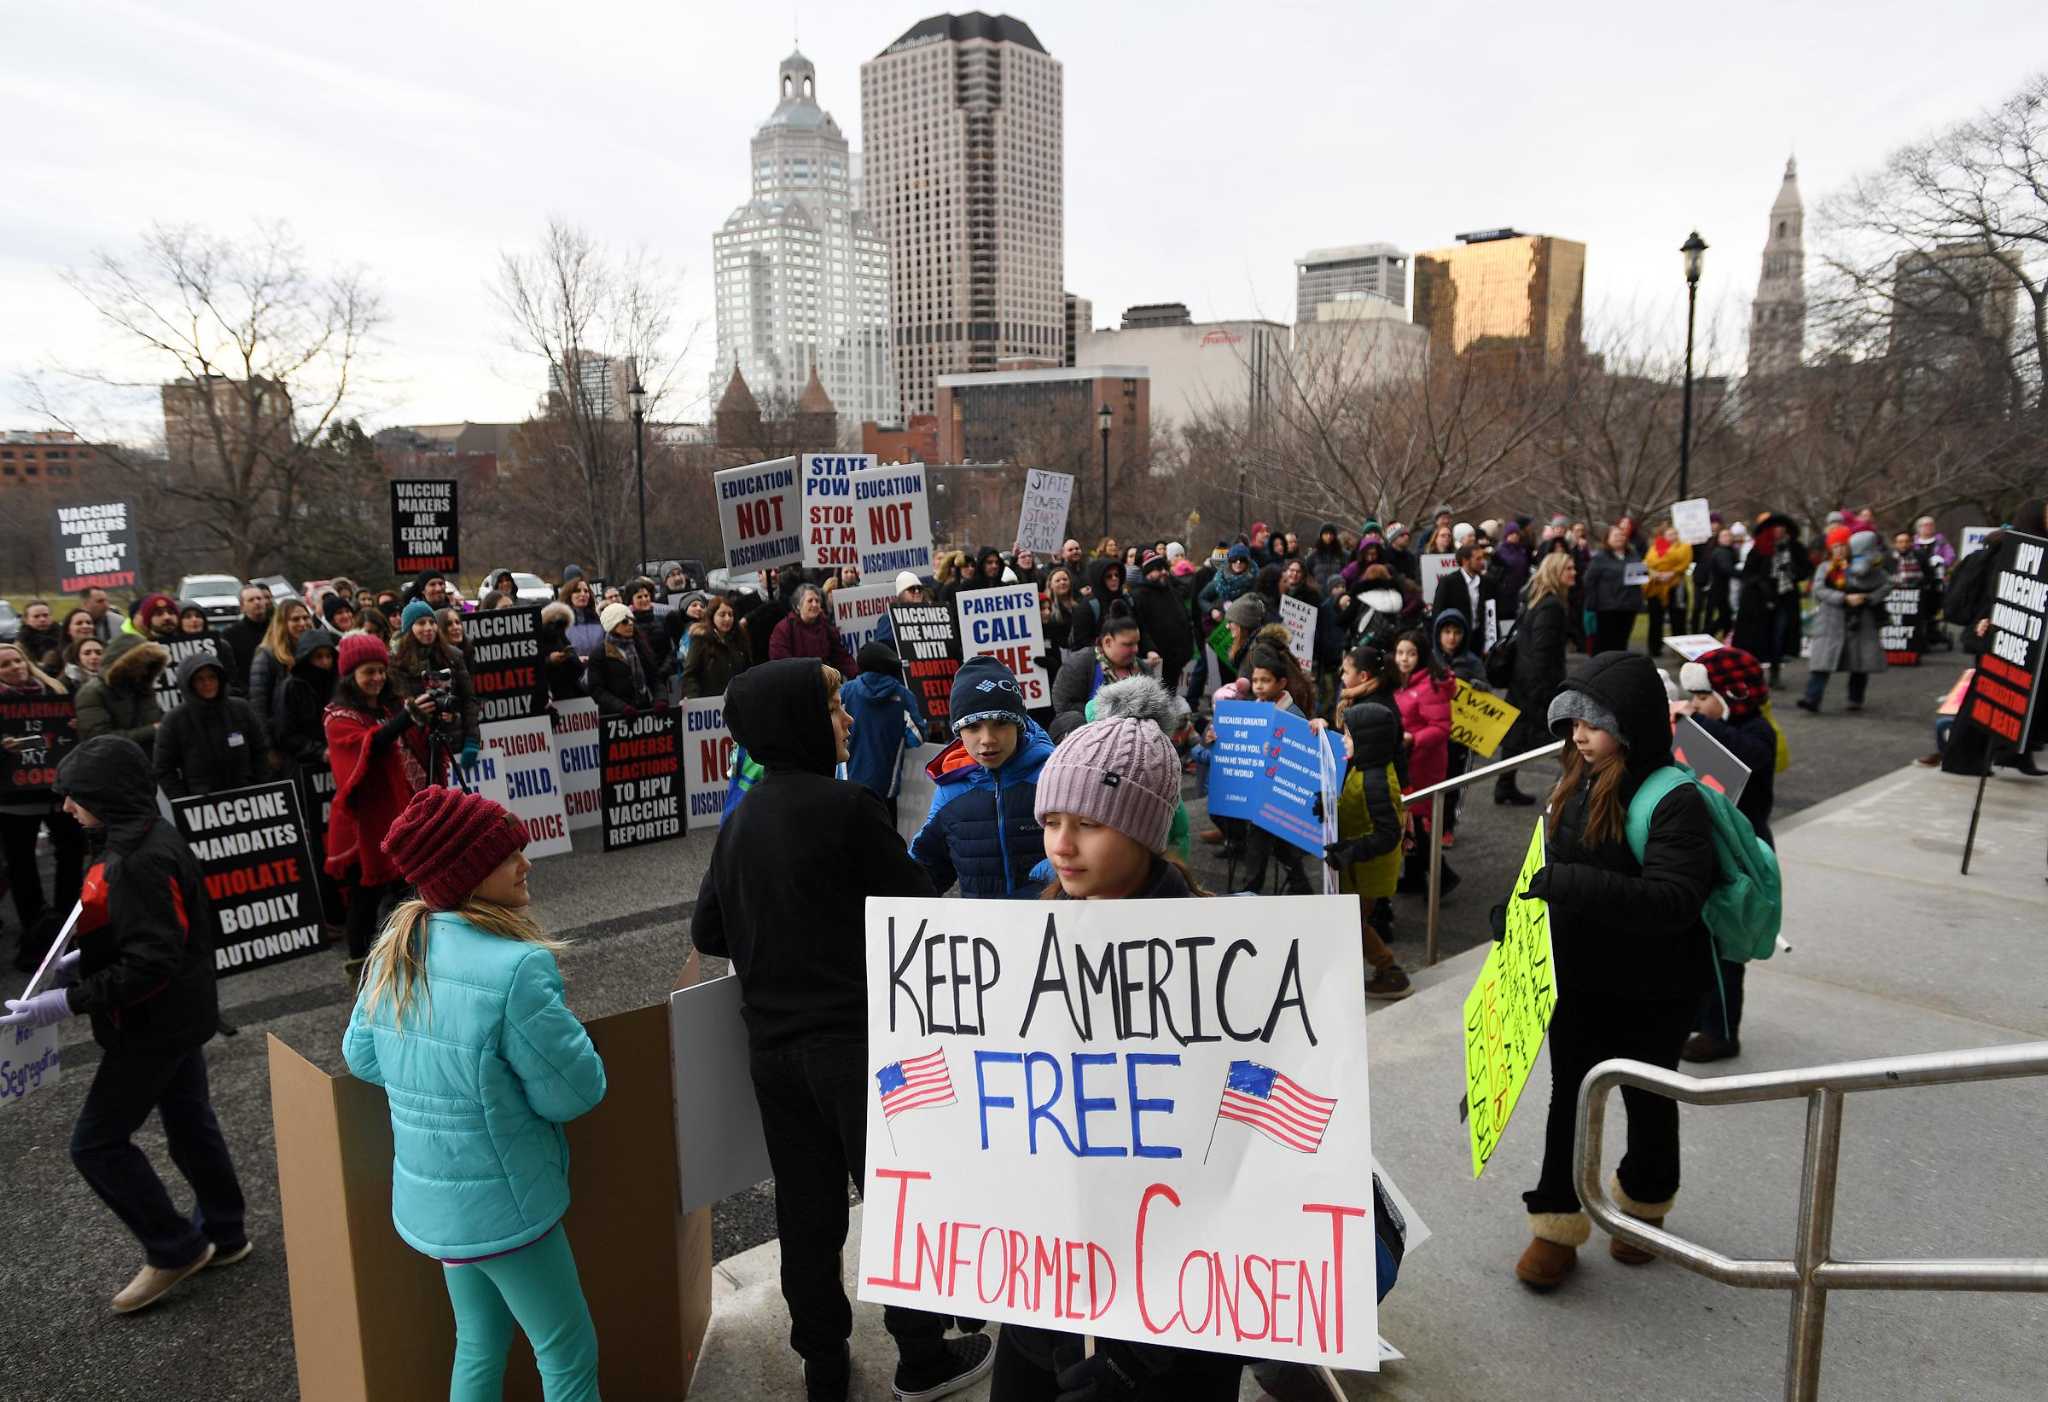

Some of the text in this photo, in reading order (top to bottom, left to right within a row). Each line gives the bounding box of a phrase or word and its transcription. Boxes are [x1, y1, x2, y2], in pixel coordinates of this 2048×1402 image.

[396, 483, 452, 497] VACCINE
[722, 469, 793, 499] EDUCATION
[807, 478, 850, 496] POW
[855, 475, 922, 500] EDUCATION
[57, 502, 127, 522] VACCINE
[398, 499, 450, 512] MAKERS
[736, 495, 784, 540] NOT
[810, 505, 854, 524] STOP
[61, 517, 127, 535] MAKERS
[413, 513, 436, 526] ARE
[868, 501, 914, 546] NOT
[81, 532, 111, 546] ARE
[400, 526, 449, 541] EXEMPT
[810, 527, 856, 545] AT M
[1024, 535, 1054, 550] SKIN
[65, 543, 127, 562] EXEMPT
[408, 541, 443, 555] FROM
[730, 534, 800, 568] DISCRIMINATION
[862, 547, 929, 574] DISCRIMINATION
[75, 557, 120, 575] FROM
[963, 592, 1034, 616] PARENTS
[1998, 571, 2048, 613] VACCINE
[893, 607, 950, 623] VACCINES
[1992, 602, 2042, 641] KNOWN TO
[900, 625, 954, 640] ARE MADE
[972, 615, 1032, 645] CALL
[912, 641, 948, 659] WITH
[1993, 630, 2029, 667] CAUSE
[923, 680, 952, 697] FETA
[478, 695, 532, 720] ODILY
[25, 720, 42, 732] IS
[21, 750, 47, 765] MY
[608, 735, 674, 761] ADVERSE
[700, 736, 735, 784] NO
[606, 757, 678, 784] REACTIONS
[613, 776, 672, 803] TO HPV
[184, 792, 288, 832] VACCINE
[609, 796, 678, 827] VACCINE
[189, 824, 298, 862] MANDATES
[609, 817, 680, 846] REPORTED
[205, 858, 301, 901] VIOLATE
[219, 893, 299, 936] BODILY
[215, 924, 320, 971] AUTONOMY
[887, 912, 1319, 1047] KEEP AMERICA
[974, 1050, 1182, 1159] FREE
[867, 1168, 1366, 1354] INFORMED CONSENT
